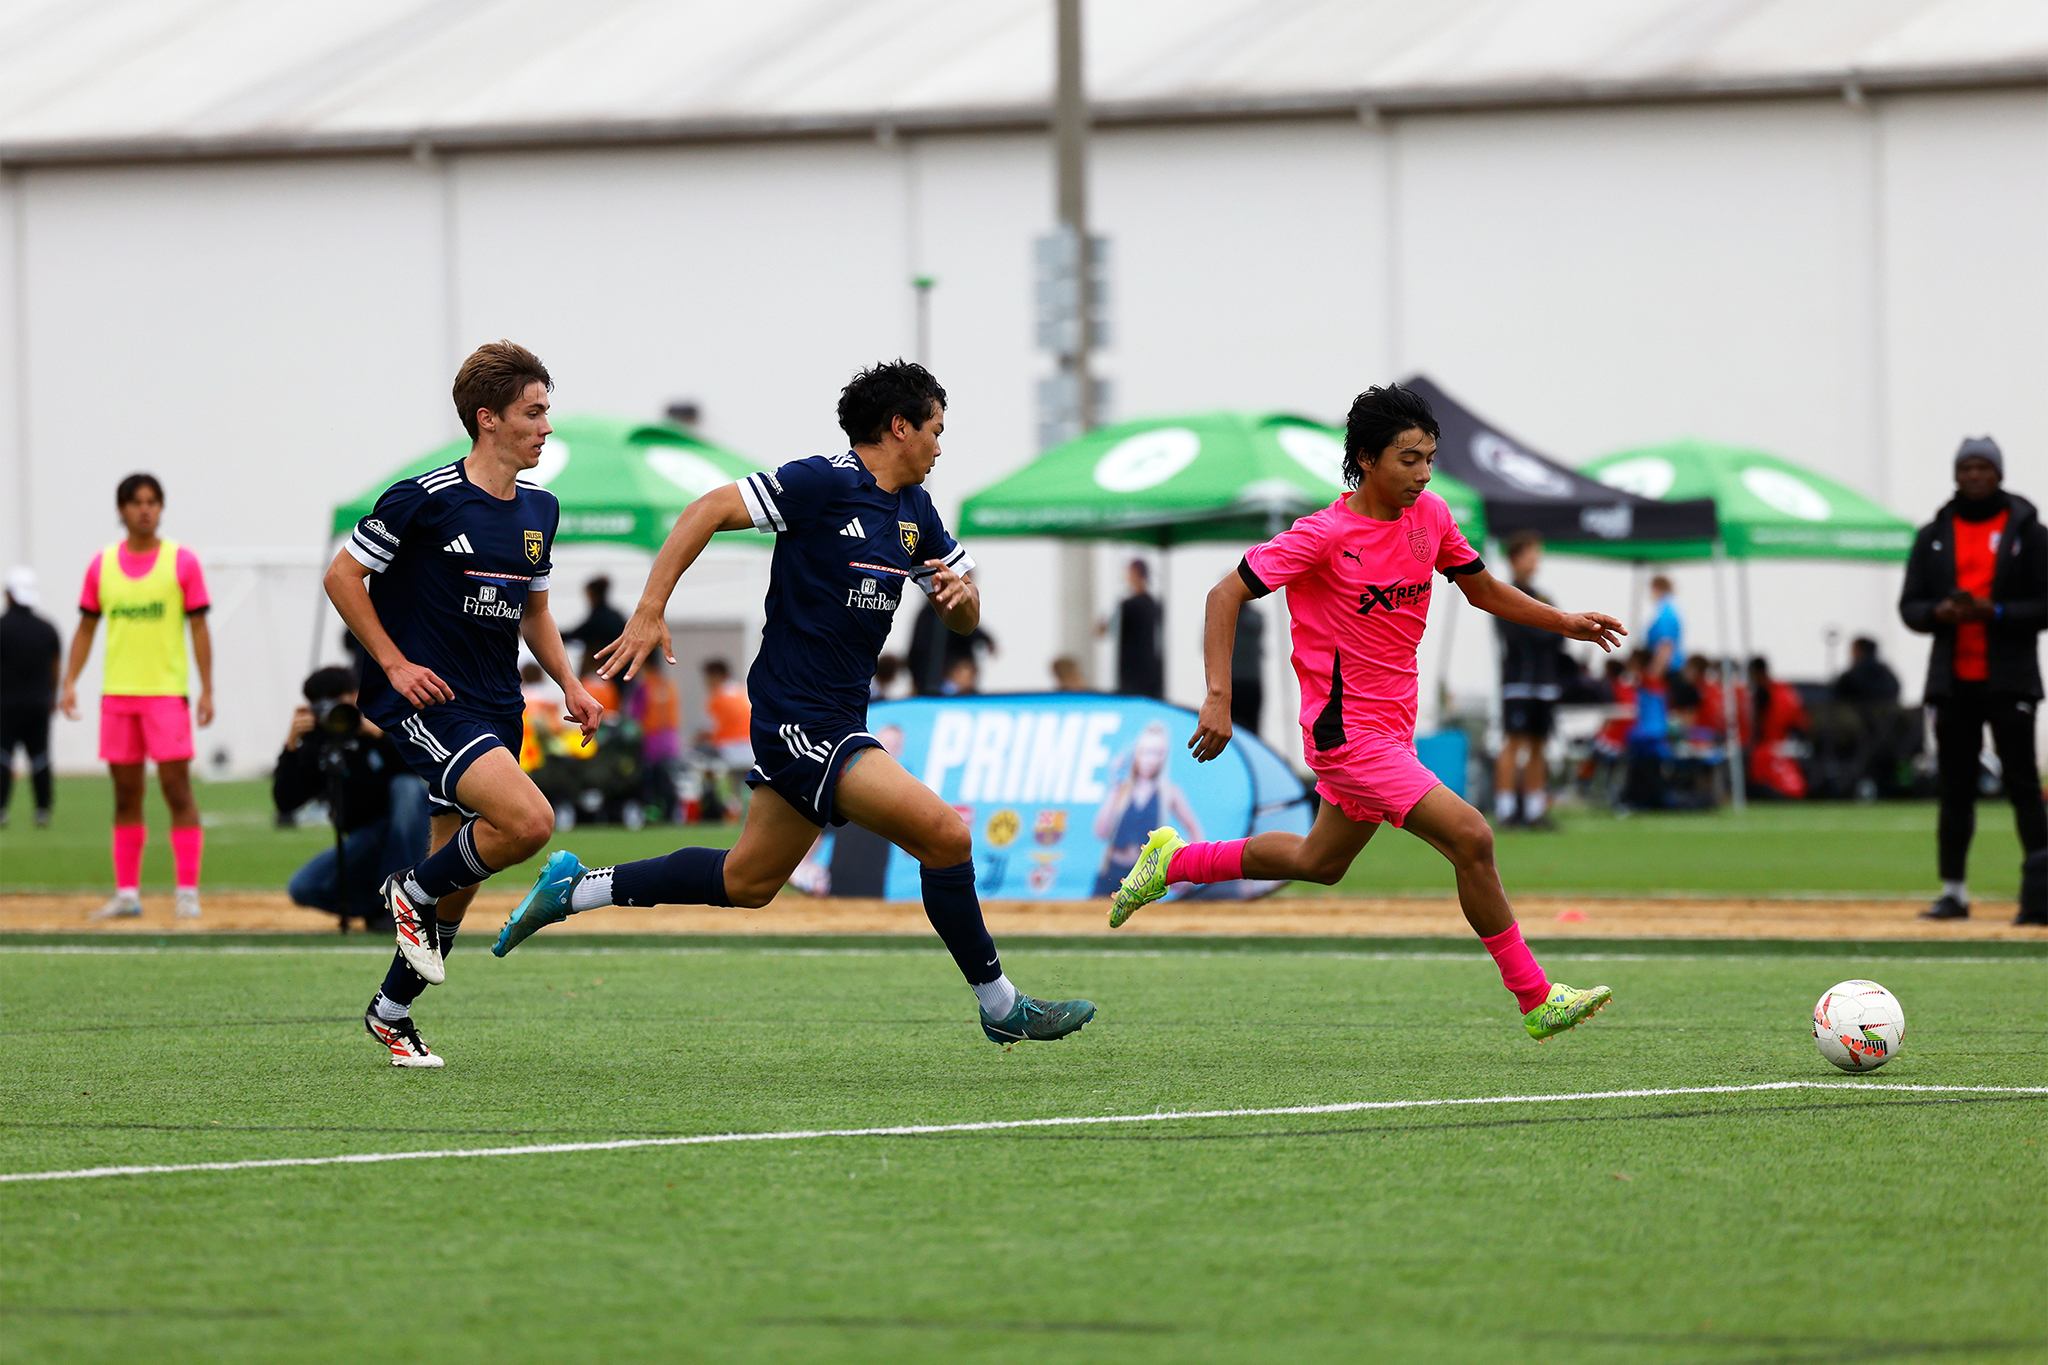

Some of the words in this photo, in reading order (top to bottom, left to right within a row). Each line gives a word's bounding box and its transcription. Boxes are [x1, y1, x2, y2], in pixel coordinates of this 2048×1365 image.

[852, 562, 910, 576] ACCELERATE
[463, 595, 523, 620] FirstBank
[923, 711, 1123, 804] PRIME
